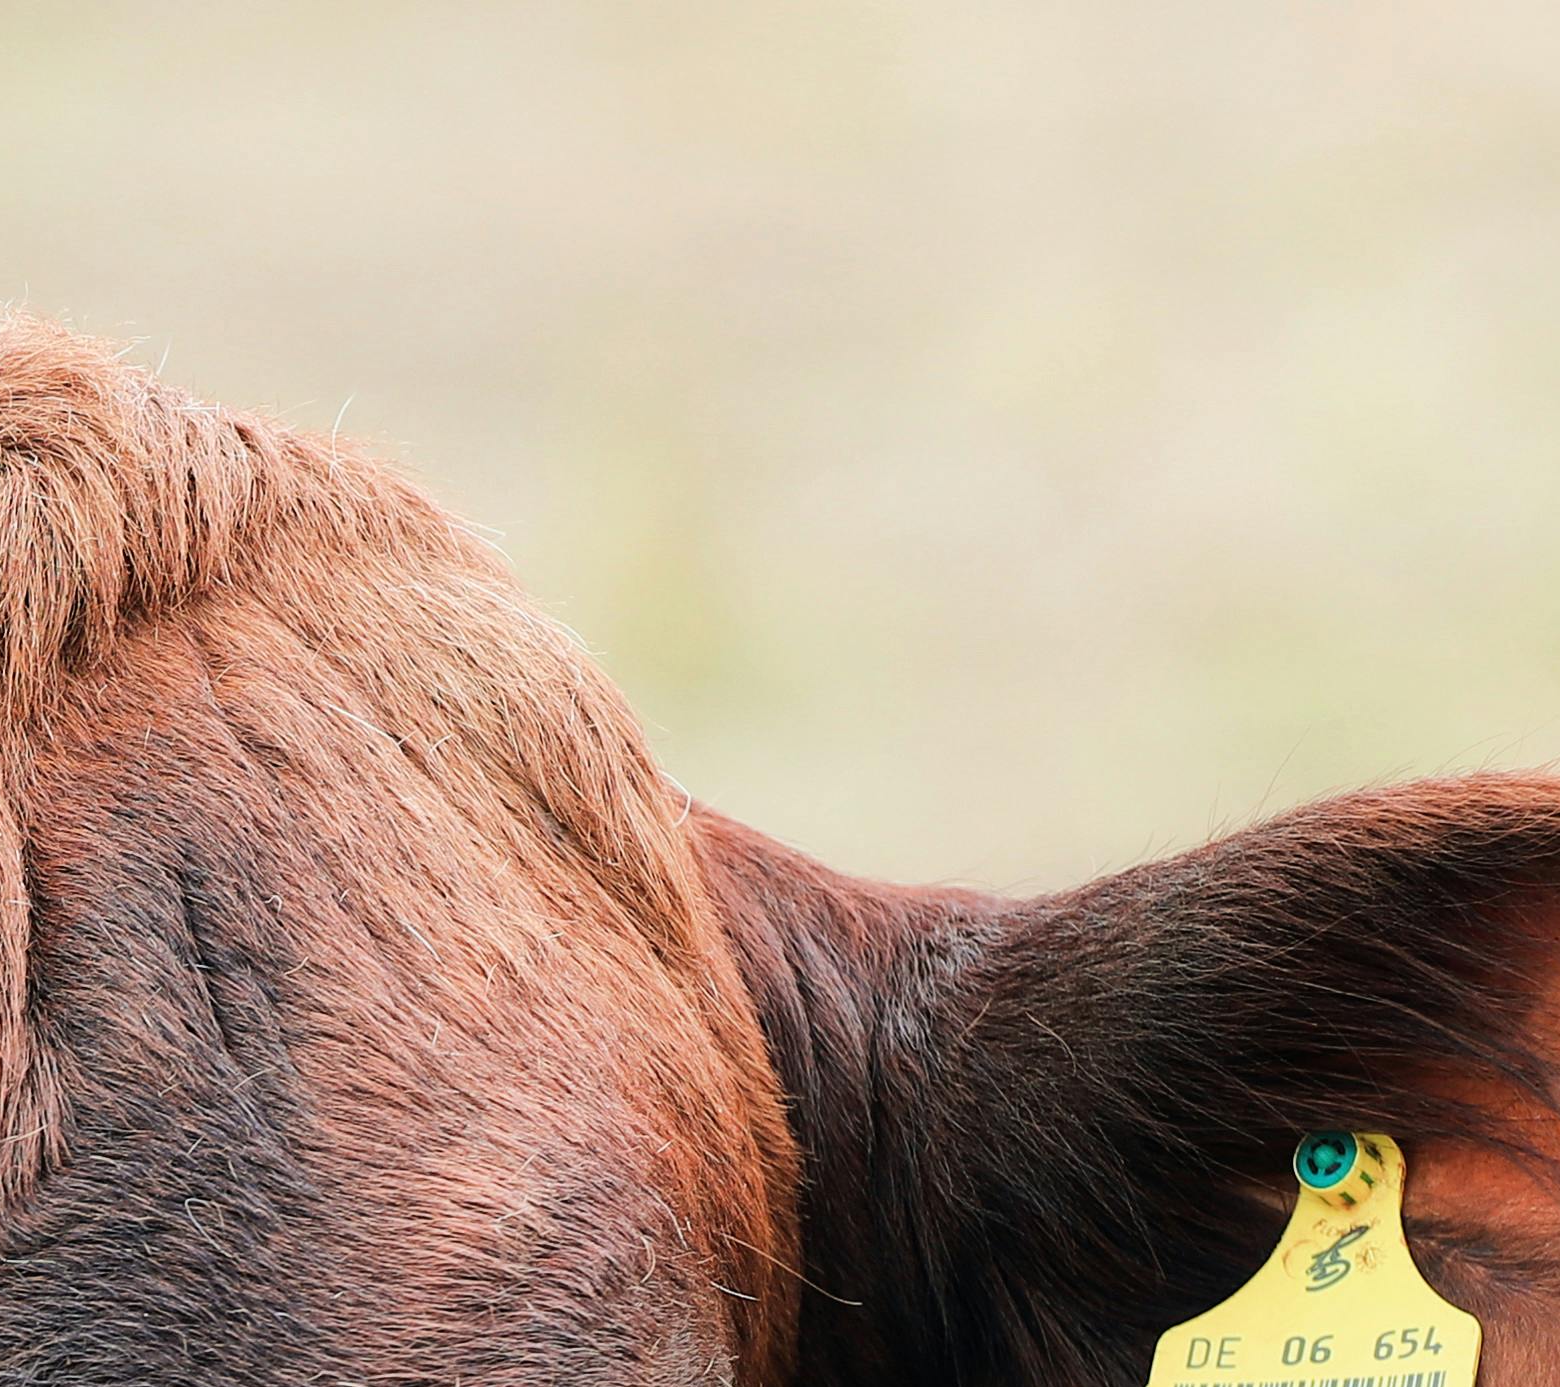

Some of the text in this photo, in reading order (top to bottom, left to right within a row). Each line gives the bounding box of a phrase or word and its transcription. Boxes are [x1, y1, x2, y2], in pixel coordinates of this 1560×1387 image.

[1185, 1326, 1443, 1369] DE 06 654
